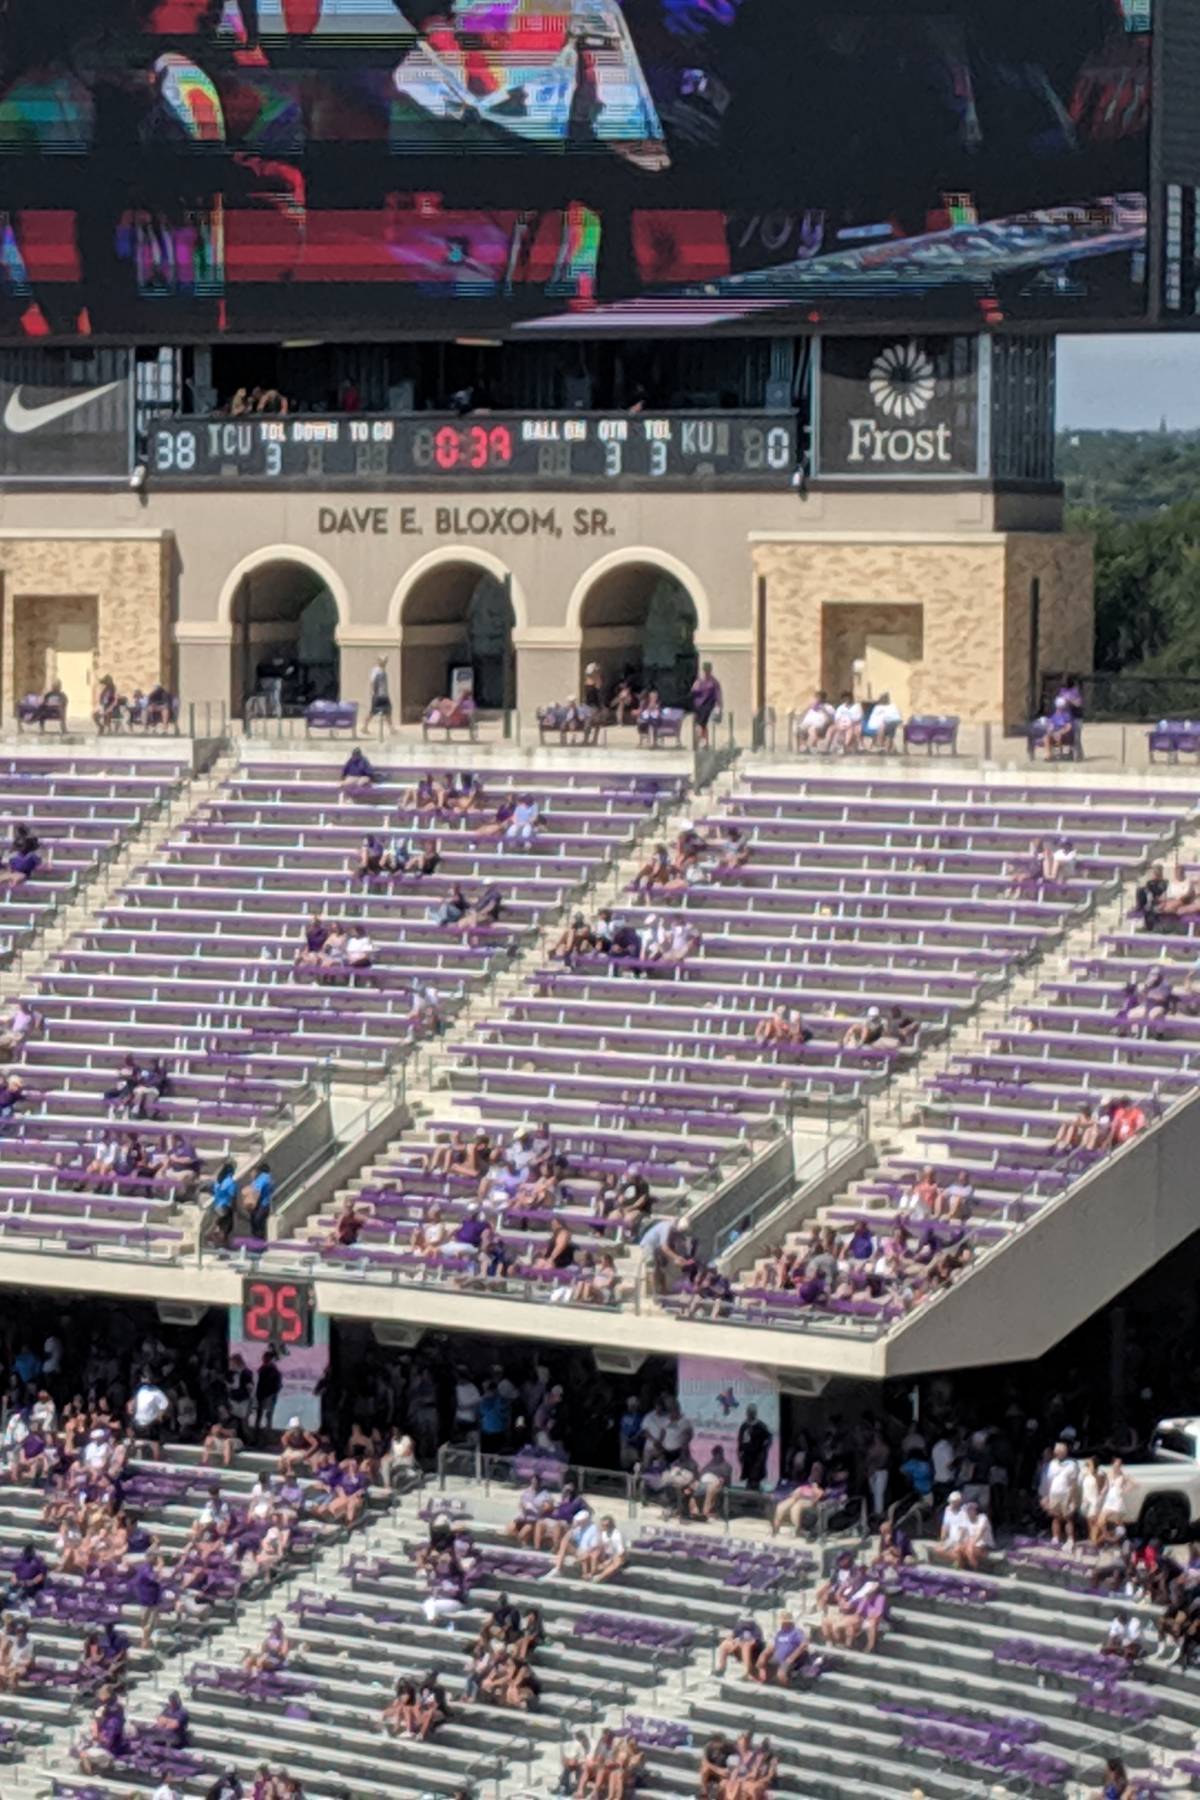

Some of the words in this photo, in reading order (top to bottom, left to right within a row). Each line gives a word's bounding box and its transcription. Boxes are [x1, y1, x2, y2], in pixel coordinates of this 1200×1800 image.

[208, 423, 251, 457] TCU
[351, 422, 369, 442] TO
[522, 420, 560, 440] BALL
[847, 419, 952, 461] Frost
[157, 430, 196, 471] 38
[265, 443, 282, 476] 3
[605, 441, 622, 476] 3
[651, 441, 667, 476] 3
[317, 507, 388, 534] DAVE
[400, 507, 423, 534] E.
[436, 507, 563, 538] BLOXOM,
[573, 508, 616, 536] SR.
[246, 1283, 303, 1341] 25
